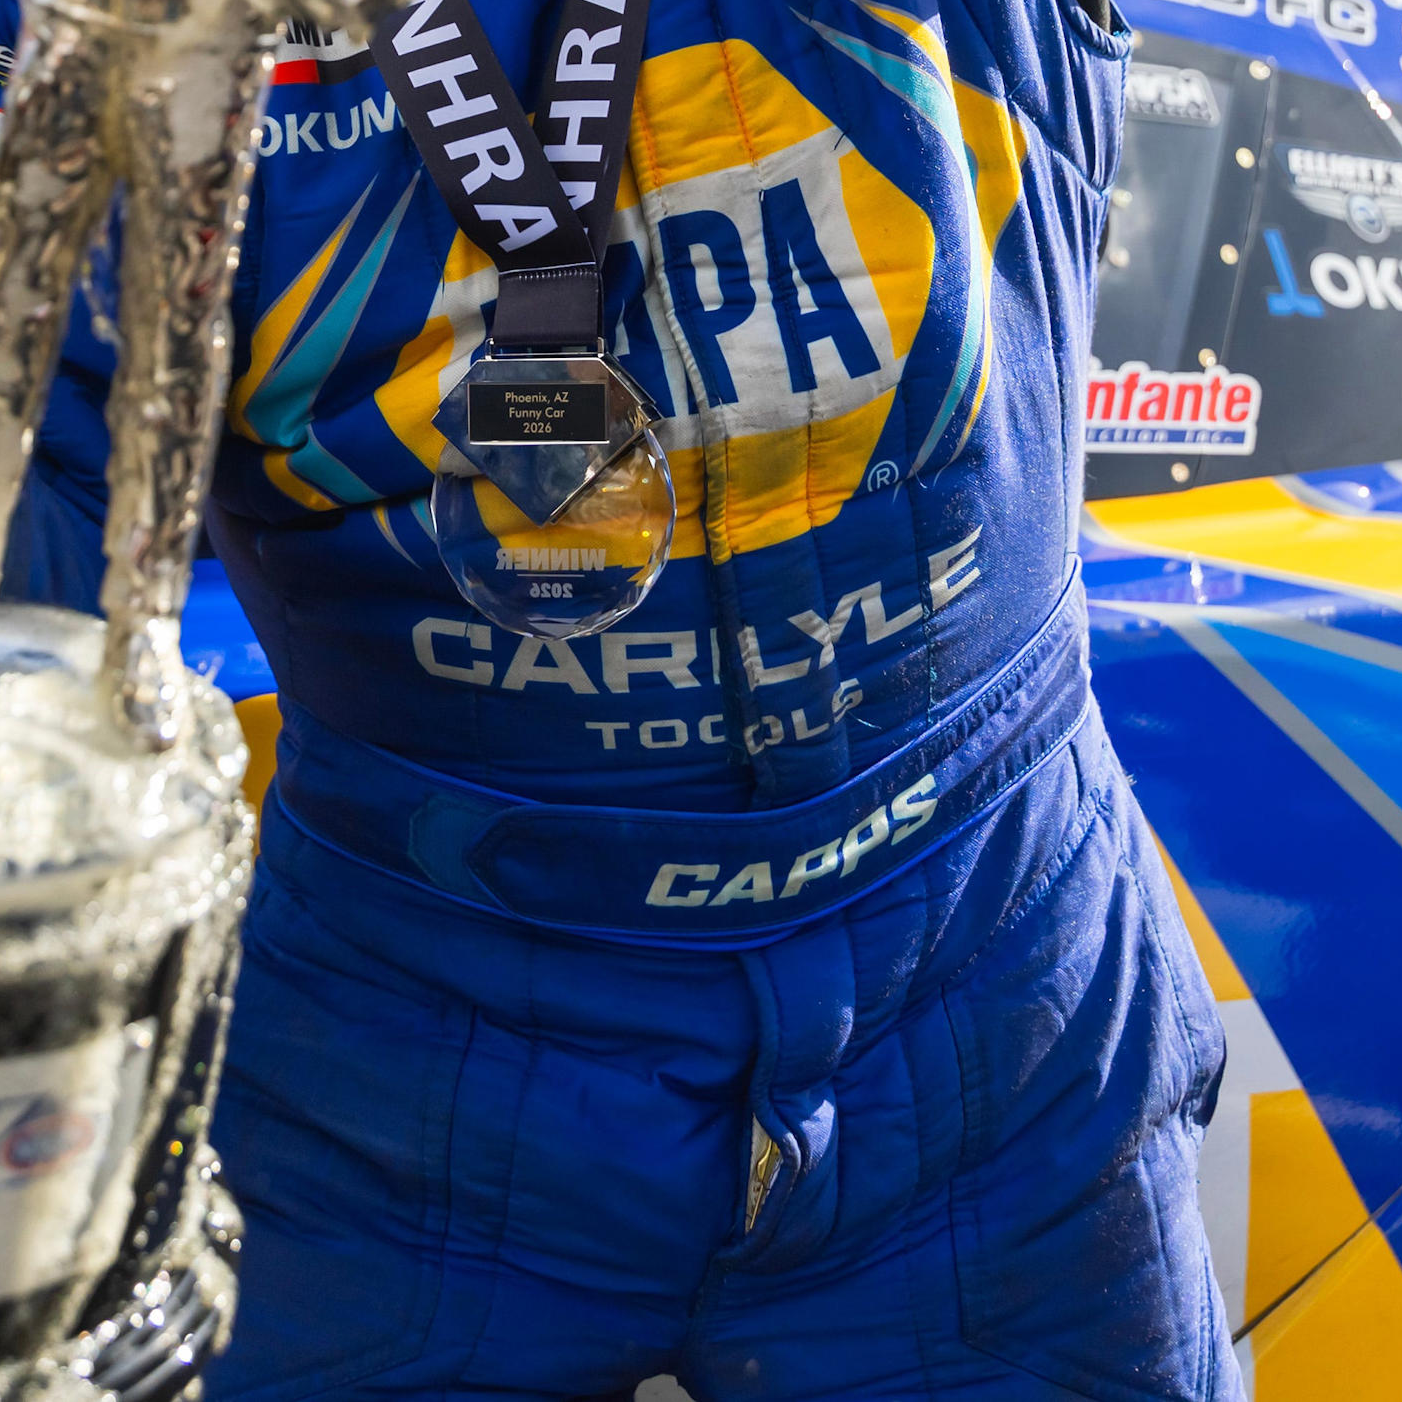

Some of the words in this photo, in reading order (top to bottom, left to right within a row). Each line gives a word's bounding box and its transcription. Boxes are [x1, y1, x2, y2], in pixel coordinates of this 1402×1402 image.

[258, 91, 406, 158] OKUM
[504, 391, 551, 404] Phoenix,
[554, 392, 569, 403] AZ
[1086, 371, 1252, 423] nfante
[508, 408, 543, 419] Funny
[544, 408, 565, 418] Car
[522, 422, 552, 434] 2026
[646, 773, 938, 908] CAPPS
